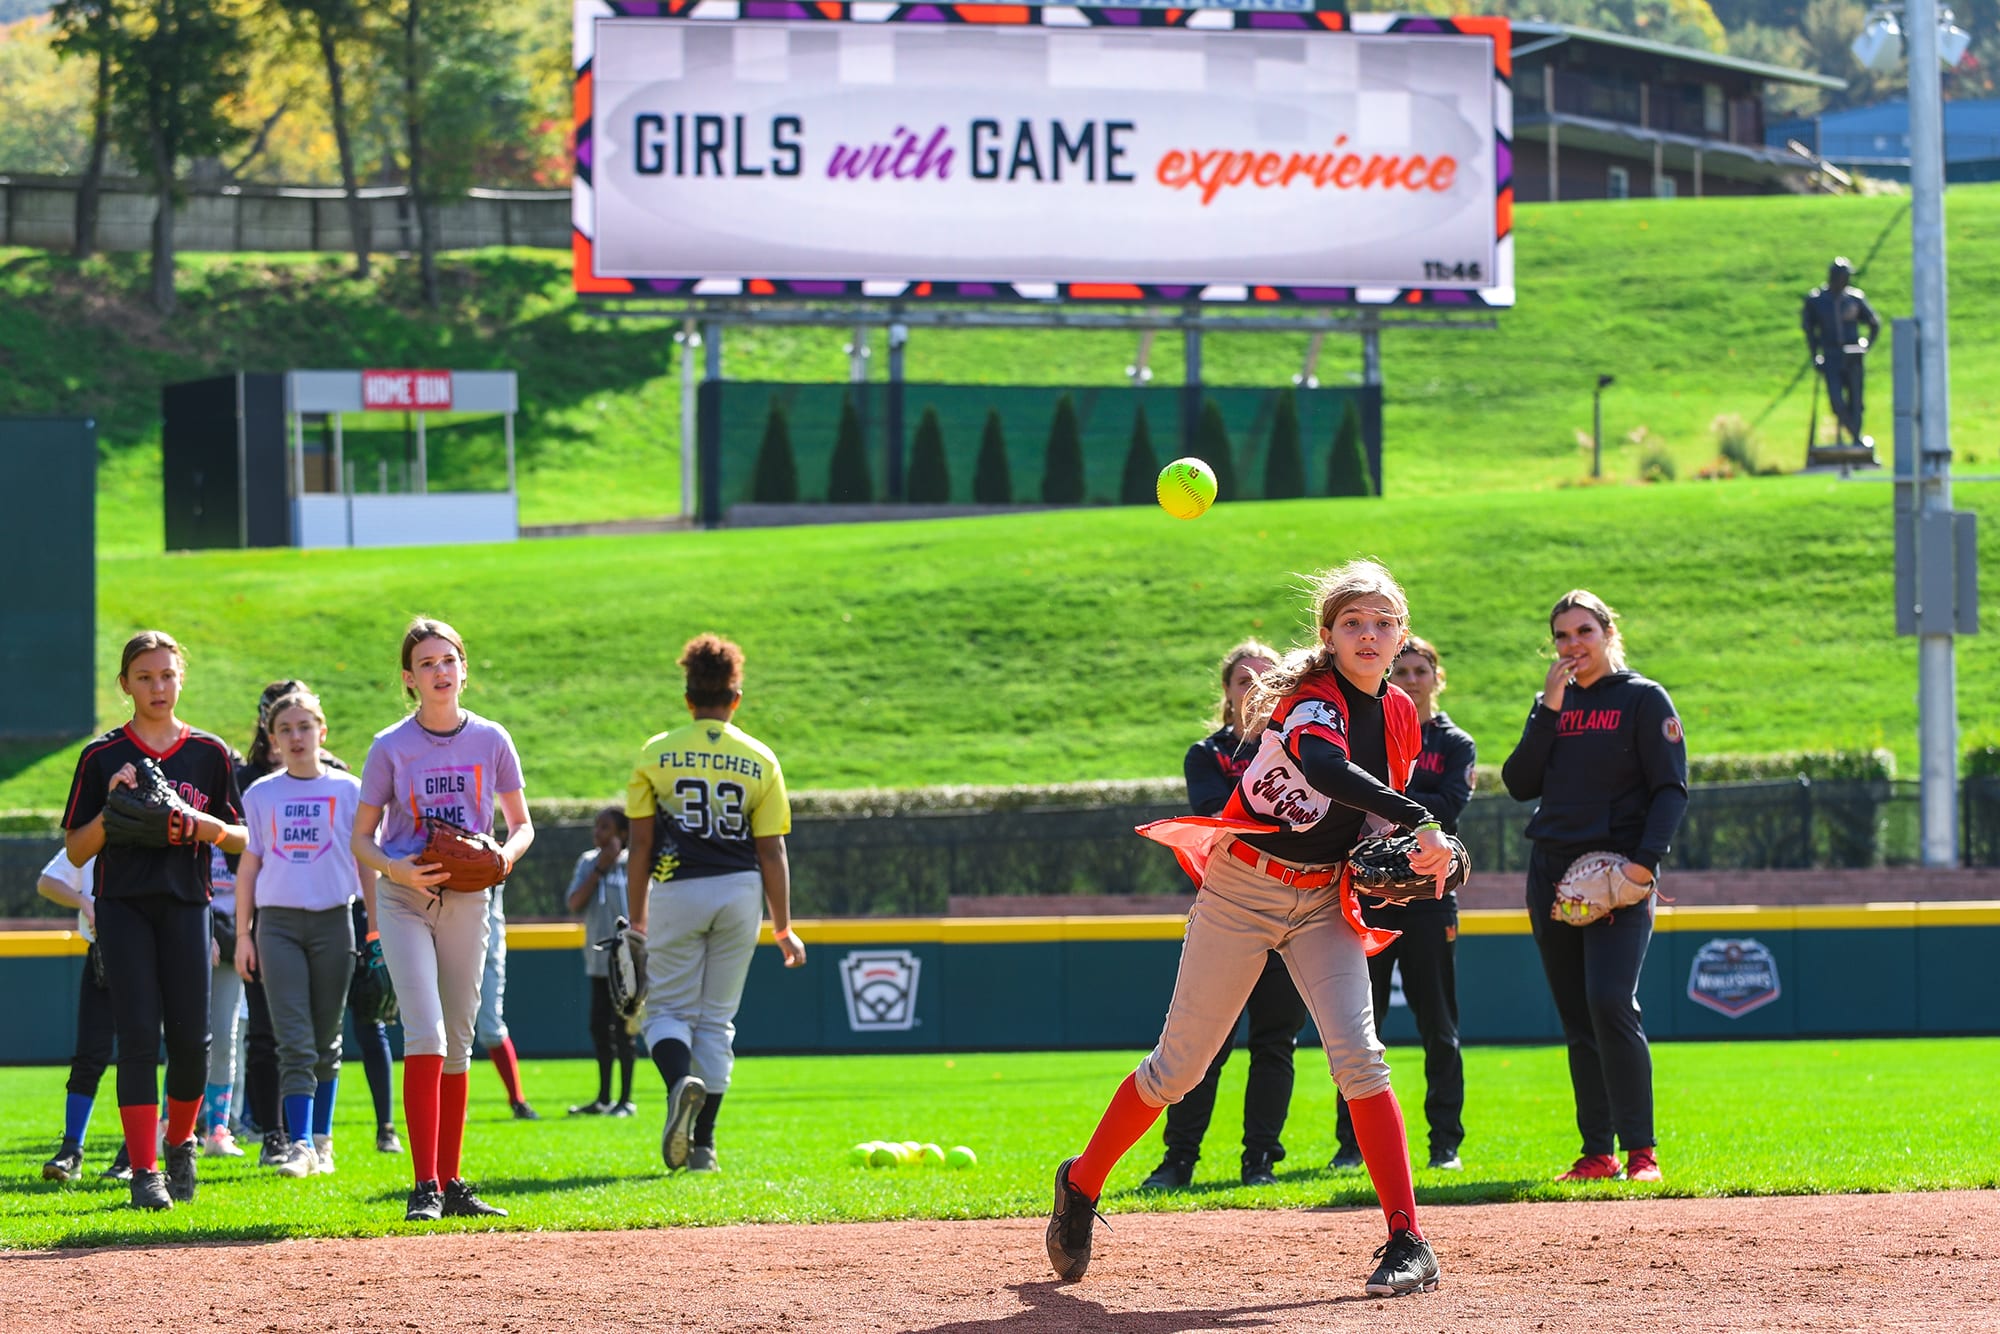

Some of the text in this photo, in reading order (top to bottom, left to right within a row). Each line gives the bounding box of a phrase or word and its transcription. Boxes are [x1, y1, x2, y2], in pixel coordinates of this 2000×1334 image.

[634, 113, 1458, 206] GIRLS with GAME experience
[1424, 260, 1482, 281] 11:46
[367, 375, 451, 404] HOME RUN
[1557, 709, 1622, 731] RYLAND
[659, 751, 763, 781] FLETCHER
[425, 776, 465, 794] GIRLS
[1252, 766, 1291, 803] Full
[285, 804, 321, 817] GIRLS
[674, 777, 749, 840] 33
[284, 828, 319, 842] GAME
